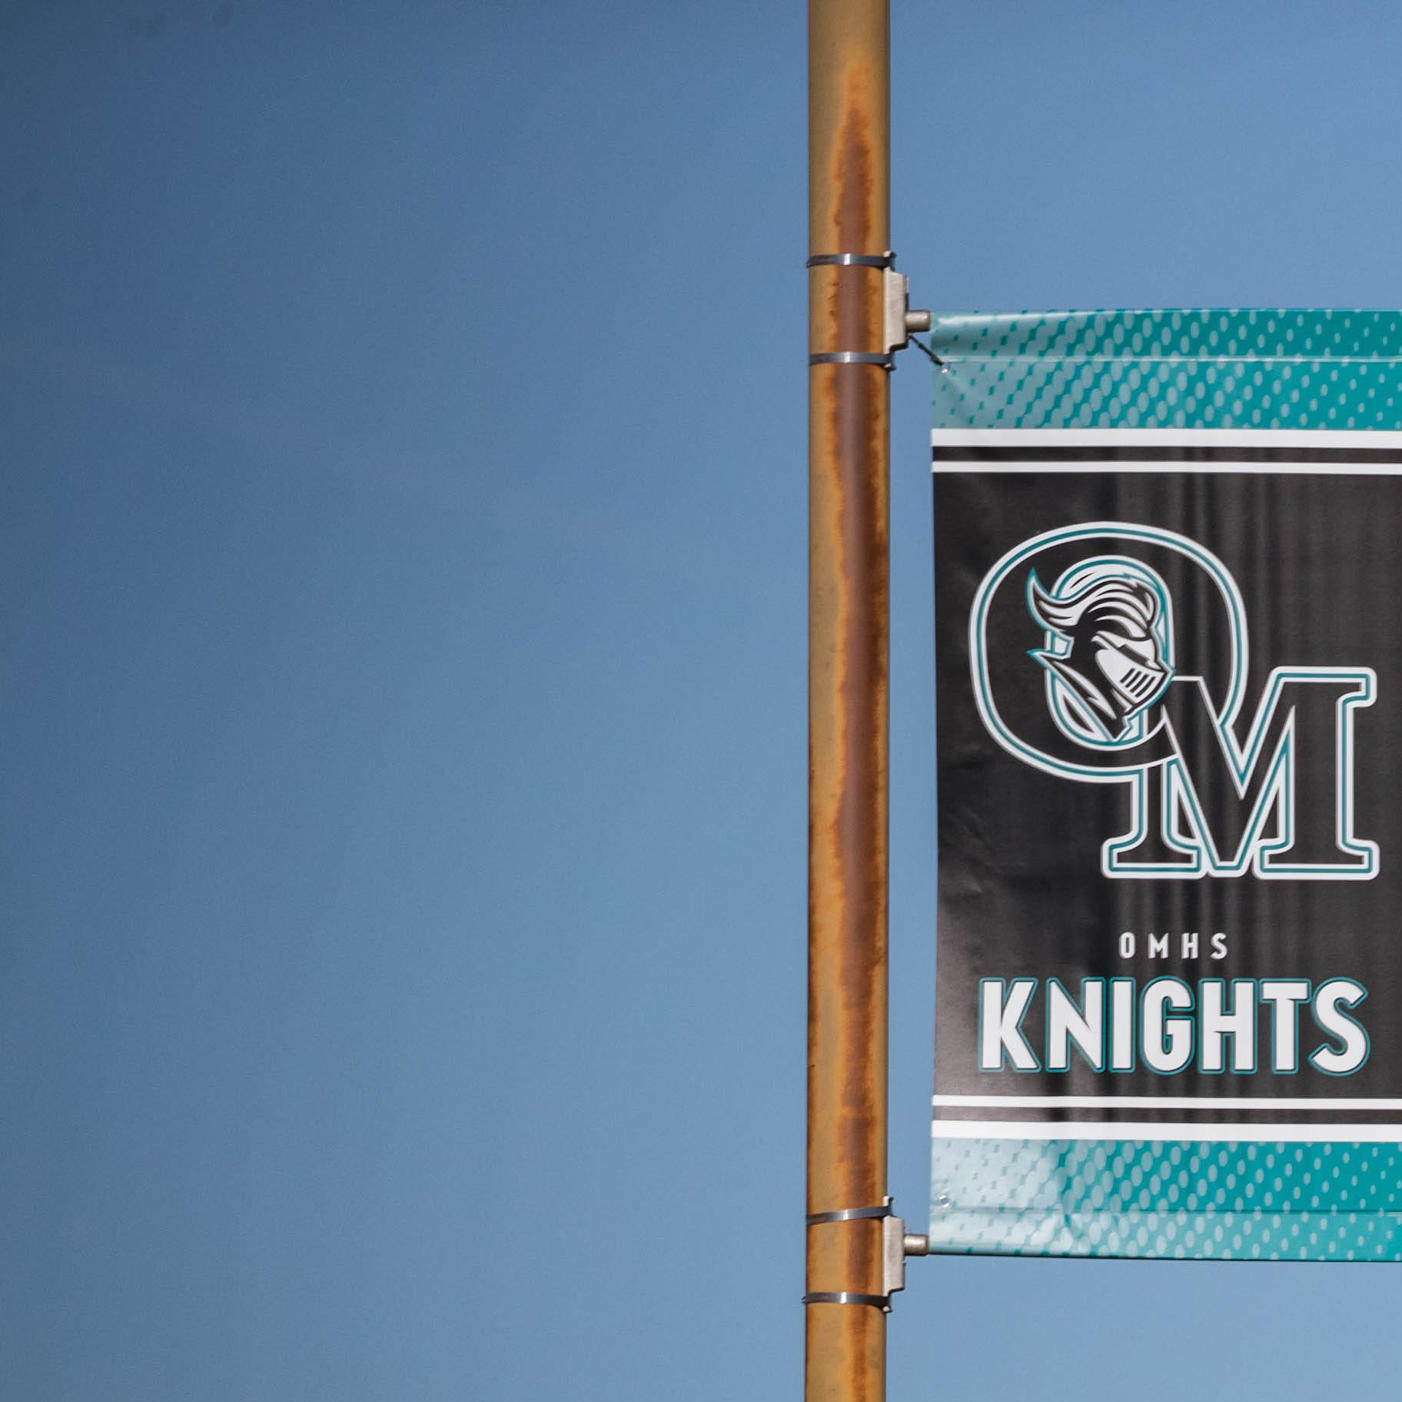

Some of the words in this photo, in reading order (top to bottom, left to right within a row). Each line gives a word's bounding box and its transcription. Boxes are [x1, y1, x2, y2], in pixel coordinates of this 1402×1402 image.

[968, 521, 1380, 880] OM
[1119, 932, 1229, 960] OMHS
[979, 976, 1371, 1076] KNIGHTS
